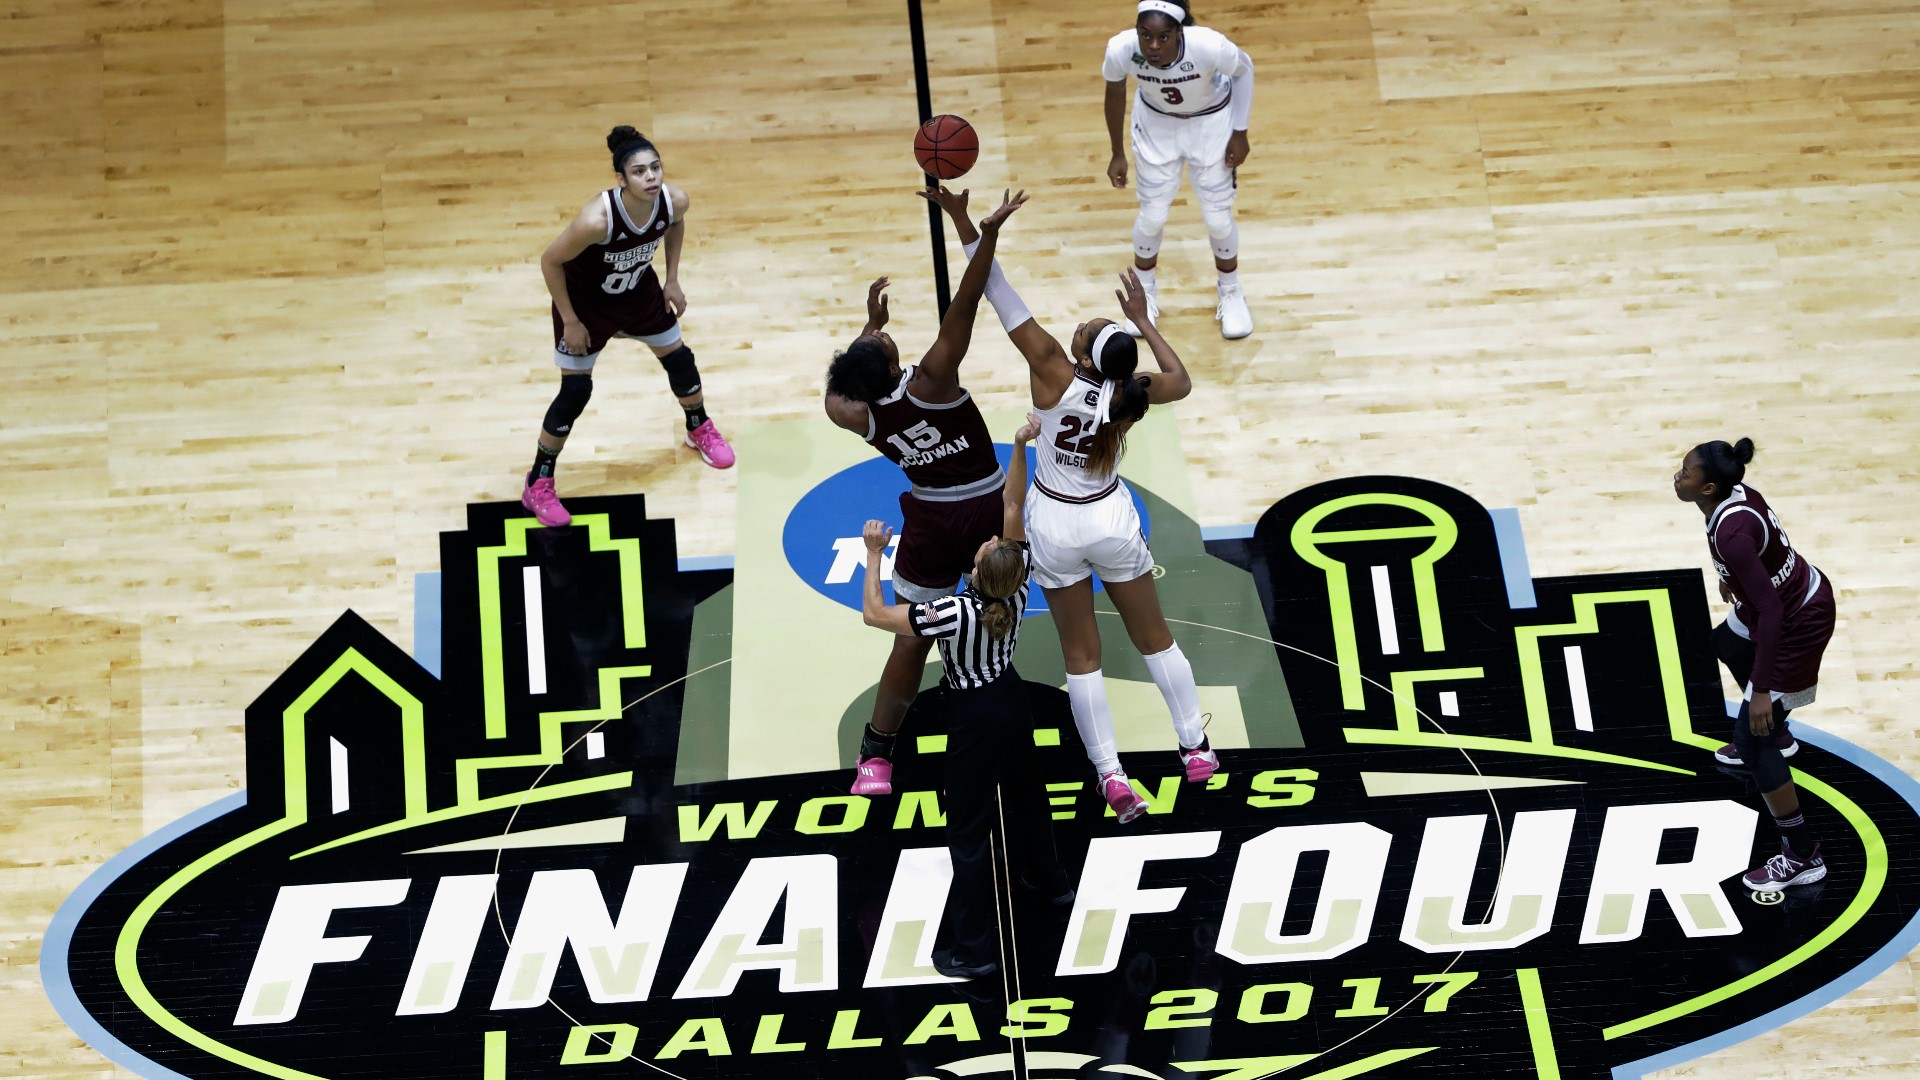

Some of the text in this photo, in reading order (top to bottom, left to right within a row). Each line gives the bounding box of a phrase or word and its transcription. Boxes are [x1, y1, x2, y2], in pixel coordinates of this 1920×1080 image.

[1162, 73, 1201, 84] CAROLINA
[1160, 86, 1185, 105] 3
[886, 419, 942, 457] 15
[1055, 451, 1089, 469] WILSO
[232, 799, 1760, 1026] FINAL FOUR
[560, 971, 1479, 1065] DALLAS 2017
